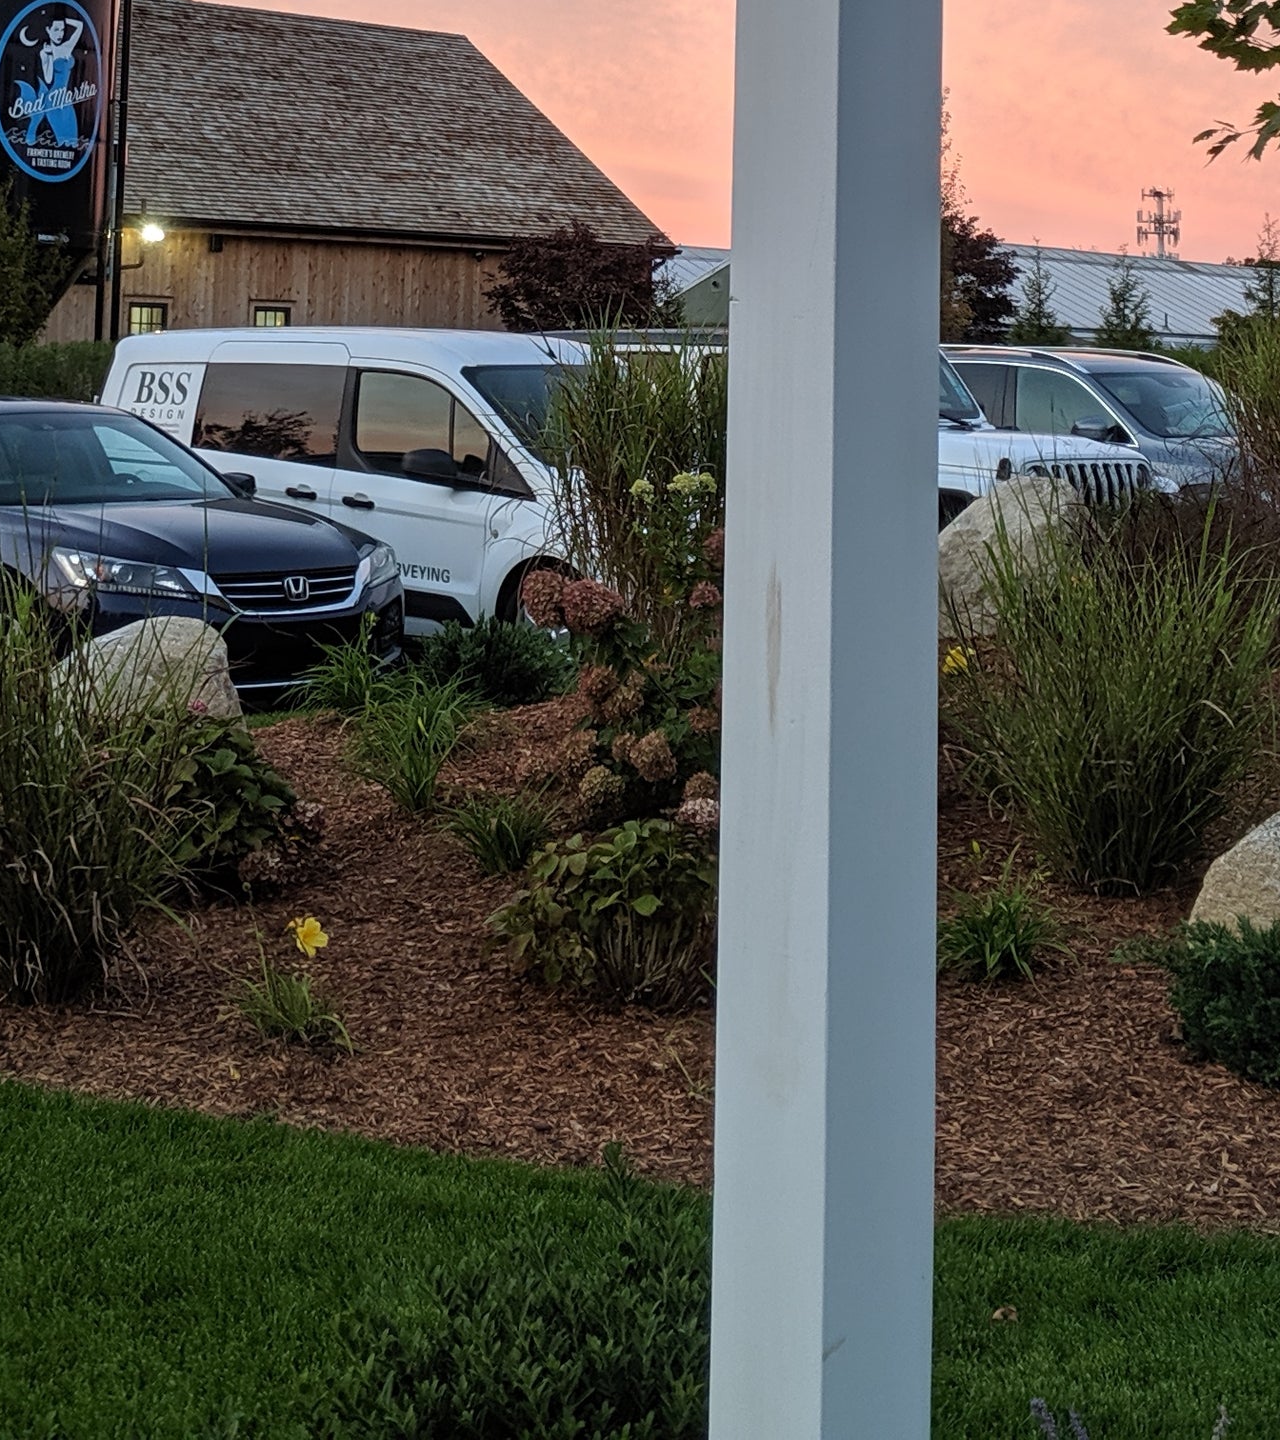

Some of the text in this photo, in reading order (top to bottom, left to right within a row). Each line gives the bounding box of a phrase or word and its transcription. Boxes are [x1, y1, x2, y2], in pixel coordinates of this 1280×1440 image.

[8, 81, 98, 119] Bad Martha
[133, 371, 193, 406] BSS
